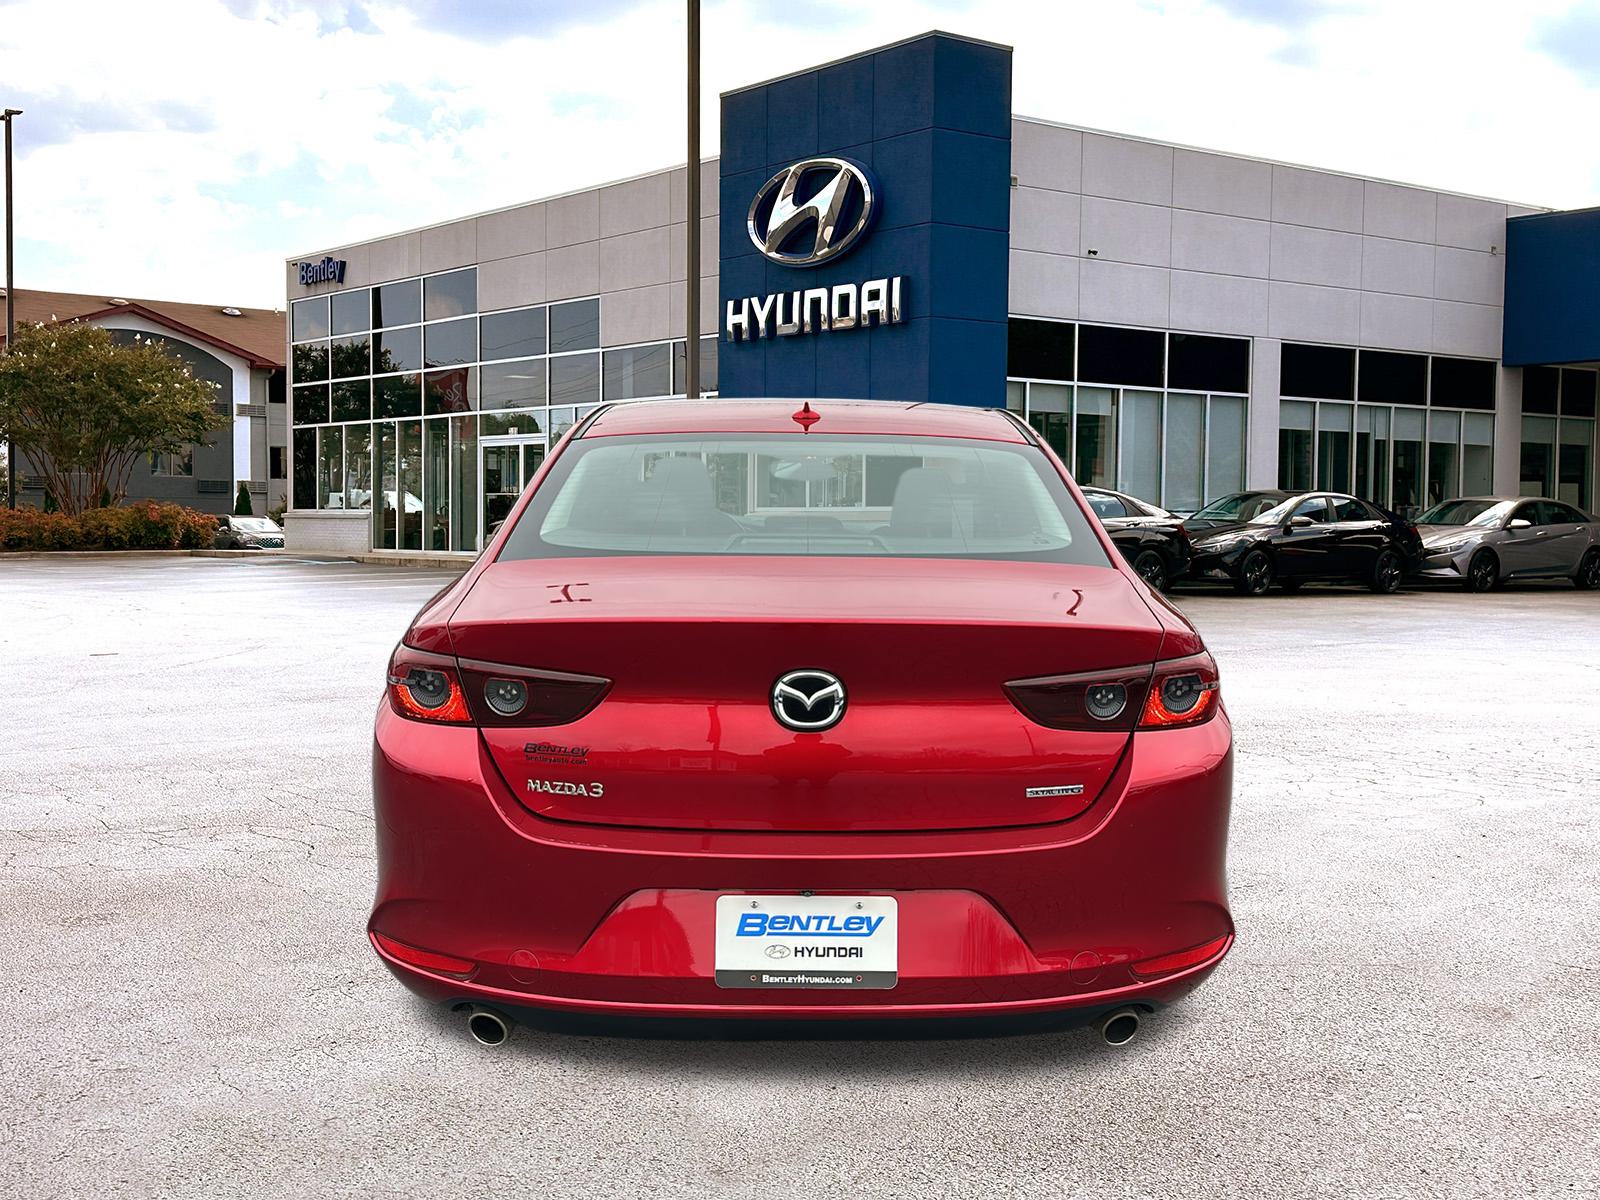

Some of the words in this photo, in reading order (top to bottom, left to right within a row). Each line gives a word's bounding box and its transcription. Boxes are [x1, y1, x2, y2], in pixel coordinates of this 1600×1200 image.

[299, 257, 343, 284] Bentley
[727, 276, 903, 342] HYUNDAI
[794, 946, 863, 958] HYUNDAI
